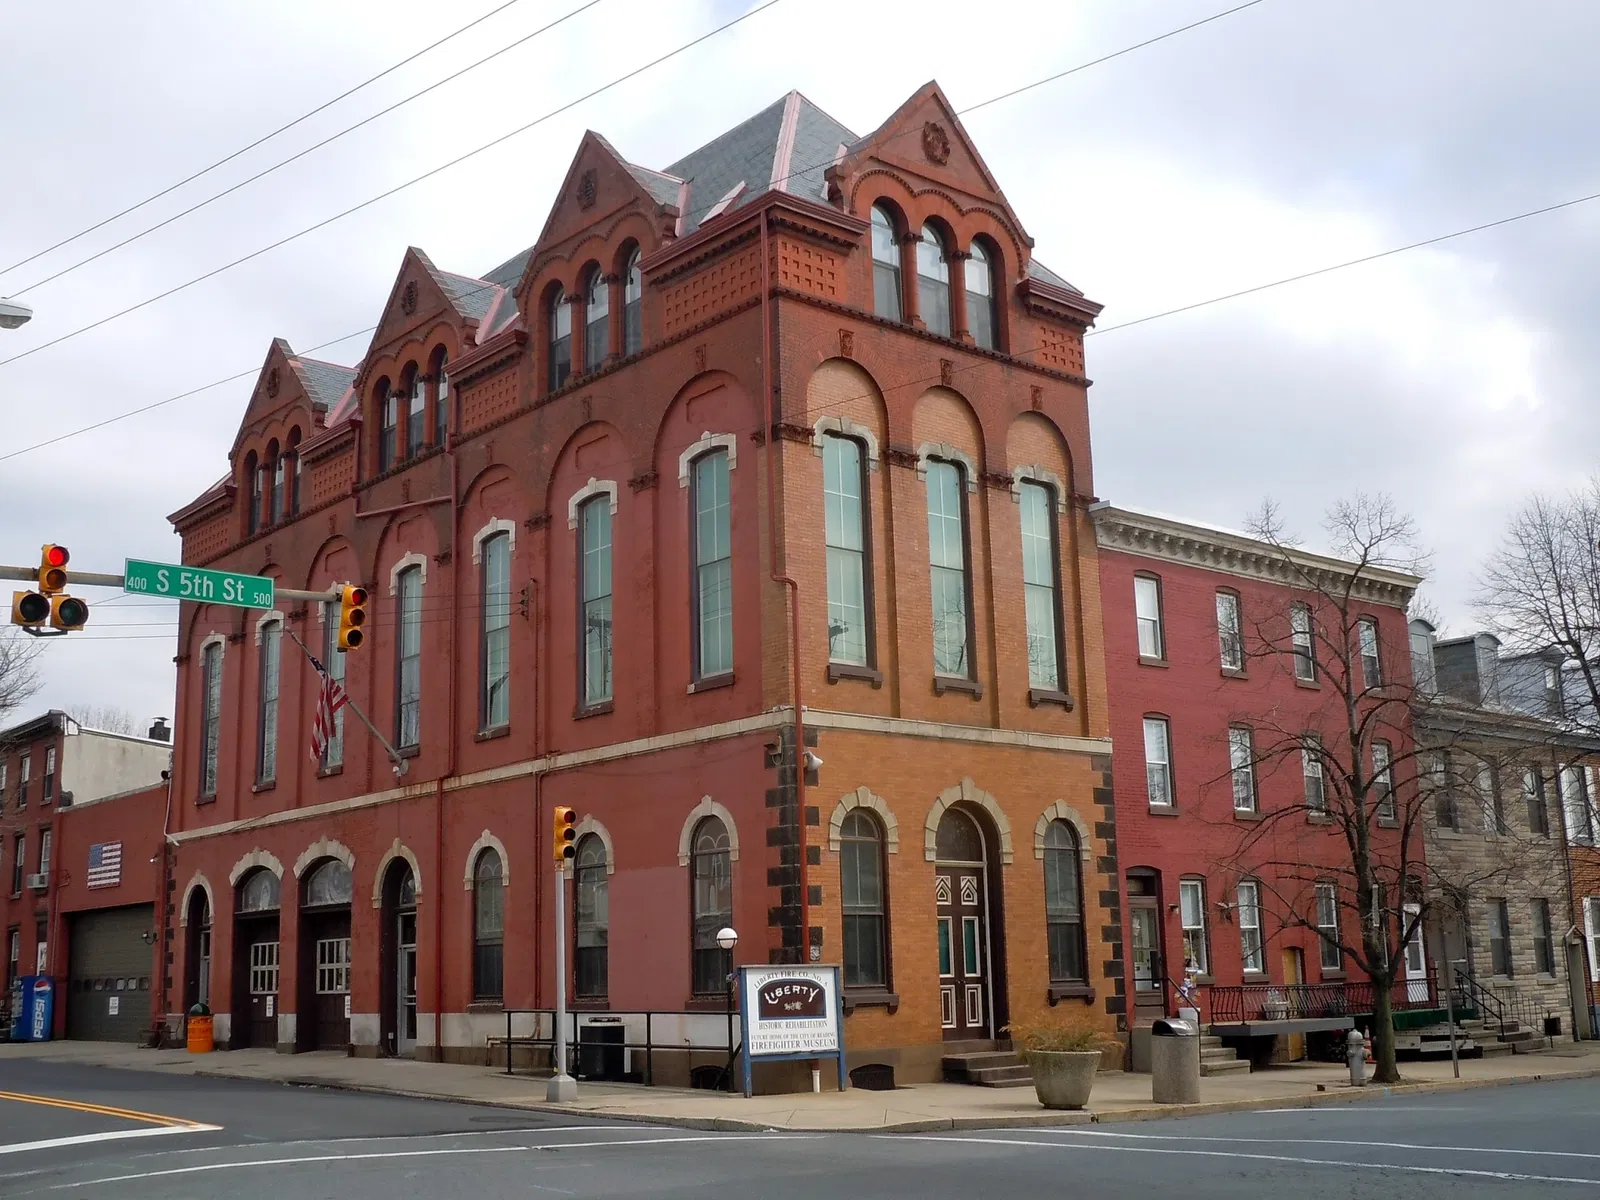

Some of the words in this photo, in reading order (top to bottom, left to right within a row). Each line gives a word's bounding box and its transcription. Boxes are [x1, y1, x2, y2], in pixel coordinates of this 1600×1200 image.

[127, 576, 147, 590] 400
[156, 569, 169, 593] S
[180, 572, 214, 598] 5th
[222, 578, 244, 601] St
[253, 592, 271, 605] 500
[754, 972, 779, 989] LIBERTY
[780, 970, 797, 978] FIRE
[764, 985, 820, 1004] LIBERTY
[33, 999, 46, 1039] PEPSI
[759, 1021, 784, 1030] HISTORIC
[785, 1020, 828, 1029] REHABILITATION
[751, 1040, 801, 1050] FIREFIGHTER
[803, 1039, 836, 1048] MUSEUM
